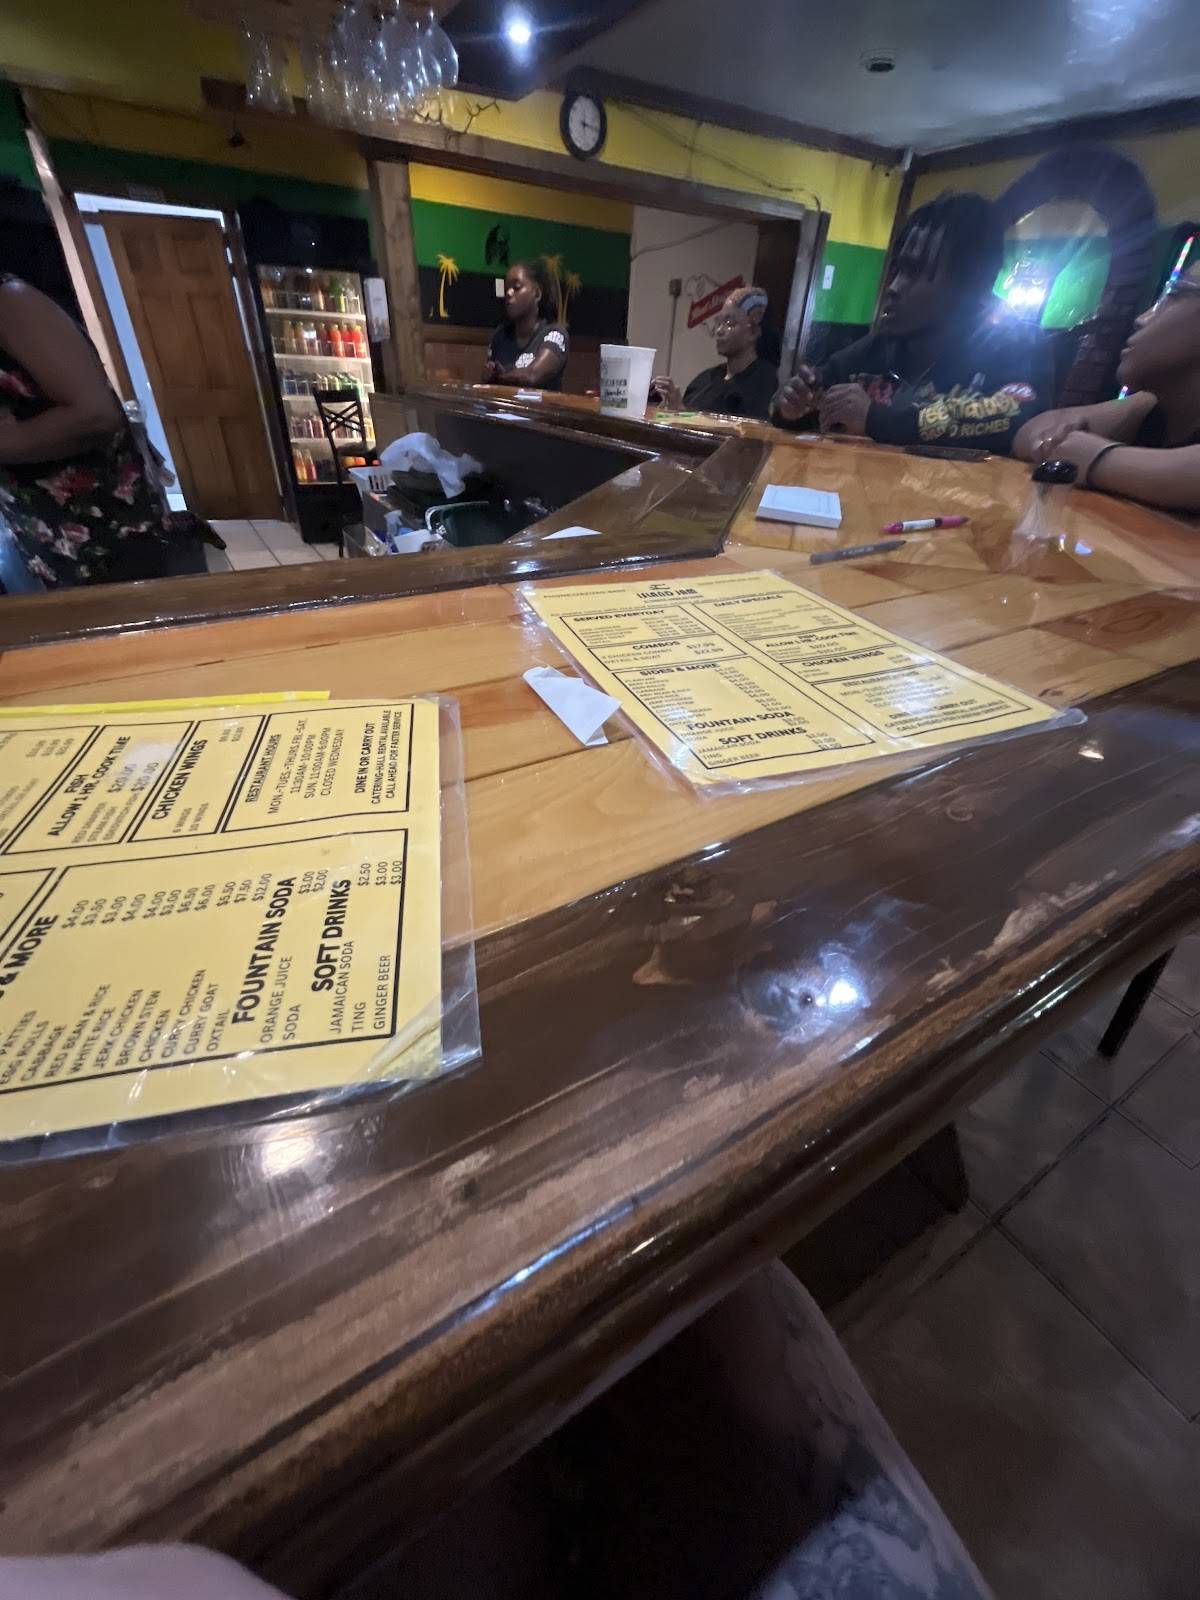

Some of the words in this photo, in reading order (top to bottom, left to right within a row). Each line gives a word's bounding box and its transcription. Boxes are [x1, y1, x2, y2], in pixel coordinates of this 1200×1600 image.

[961, 417, 1010, 437] RICHES
[632, 641, 680, 650] COMBOS
[802, 658, 849, 666] CHICKEN
[849, 650, 884, 659] WINGS
[640, 668, 675, 676] SIDES
[364, 723, 375, 733] OUT
[380, 710, 390, 734] AVAILABLE
[392, 712, 401, 729] SERVICE
[687, 717, 756, 730] FOUNTAIN
[756, 711, 794, 720] SODA
[361, 735, 373, 755] CARRY
[377, 734, 387, 754] RENTAL
[390, 731, 399, 748] FASTER
[718, 734, 754, 745] SOFT
[755, 727, 807, 739] DRINKS
[245, 757, 270, 802] RESTAURANT
[265, 734, 281, 756] HOURS
[320, 768, 336, 795] CLOSED
[328, 729, 343, 766] WEDNESDAY
[359, 756, 370, 765] OR
[390, 749, 398, 760] FOR
[64, 774, 89, 793] FISH
[151, 772, 191, 820] CHICKEN
[179, 739, 208, 770] WINGS
[354, 775, 367, 793] DINE
[371, 755, 385, 804] CATERING-HALL
[387, 762, 397, 781] AHEAD
[47, 803, 82, 836] ALLOW
[79, 780, 100, 794] HR.
[92, 756, 116, 778] COOK
[108, 736, 130, 754] TIME
[304, 782, 317, 798] SUN.
[385, 783, 395, 798] CALL
[298, 872, 315, 894] $3.00
[312, 870, 328, 891] $2.00
[357, 863, 371, 886] $2.50
[375, 861, 387, 886] $3.00
[390, 860, 402, 884] $3.00
[176, 888, 198, 913] $6.50
[194, 884, 215, 911] $6.00
[216, 881, 236, 906] $5.50
[233, 880, 251, 903] $7.50
[252, 873, 272, 901] $12.00
[61, 900, 89, 928] $4.00
[101, 896, 127, 924] $3.00
[121, 894, 146, 921] $4.00
[142, 891, 166, 918] $4.00
[159, 889, 182, 916] $3.00
[321, 880, 351, 939] DRINKS
[3, 915, 58, 968] MORE
[231, 922, 282, 1024] FOUNTAIN
[265, 877, 296, 918] SODA
[339, 940, 354, 969] SODA
[311, 943, 340, 992] SOFT
[378, 955, 390, 980] BEER
[161, 1019, 186, 1057] CURRY
[179, 969, 206, 1015] CHICKEN
[259, 990, 284, 1043] ORANGE
[274, 956, 292, 988] JUICE
[330, 972, 350, 1034] JAMAICAN
[373, 984, 388, 1029] GINGER
[94, 1041, 114, 1068] JERK
[110, 989, 143, 1037] CHICKEN
[115, 1021, 146, 1066] BROWN
[138, 990, 161, 1019] STEW
[184, 1016, 207, 1054] CURRY
[200, 984, 218, 1012] GOAT
[206, 1009, 230, 1051] OXTAIL
[283, 1004, 301, 1040] SODA
[351, 1002, 366, 1031] TING
[17, 1021, 49, 1056] ROLLS
[44, 1053, 68, 1077] RED
[62, 1019, 89, 1050] BEAN
[88, 985, 110, 1007] RICE
[70, 1036, 98, 1073] WHITE
[92, 1009, 114, 1032] RICE
[138, 1009, 170, 1062] CHICKEN
[20, 1026, 65, 1081] CABBAGE
